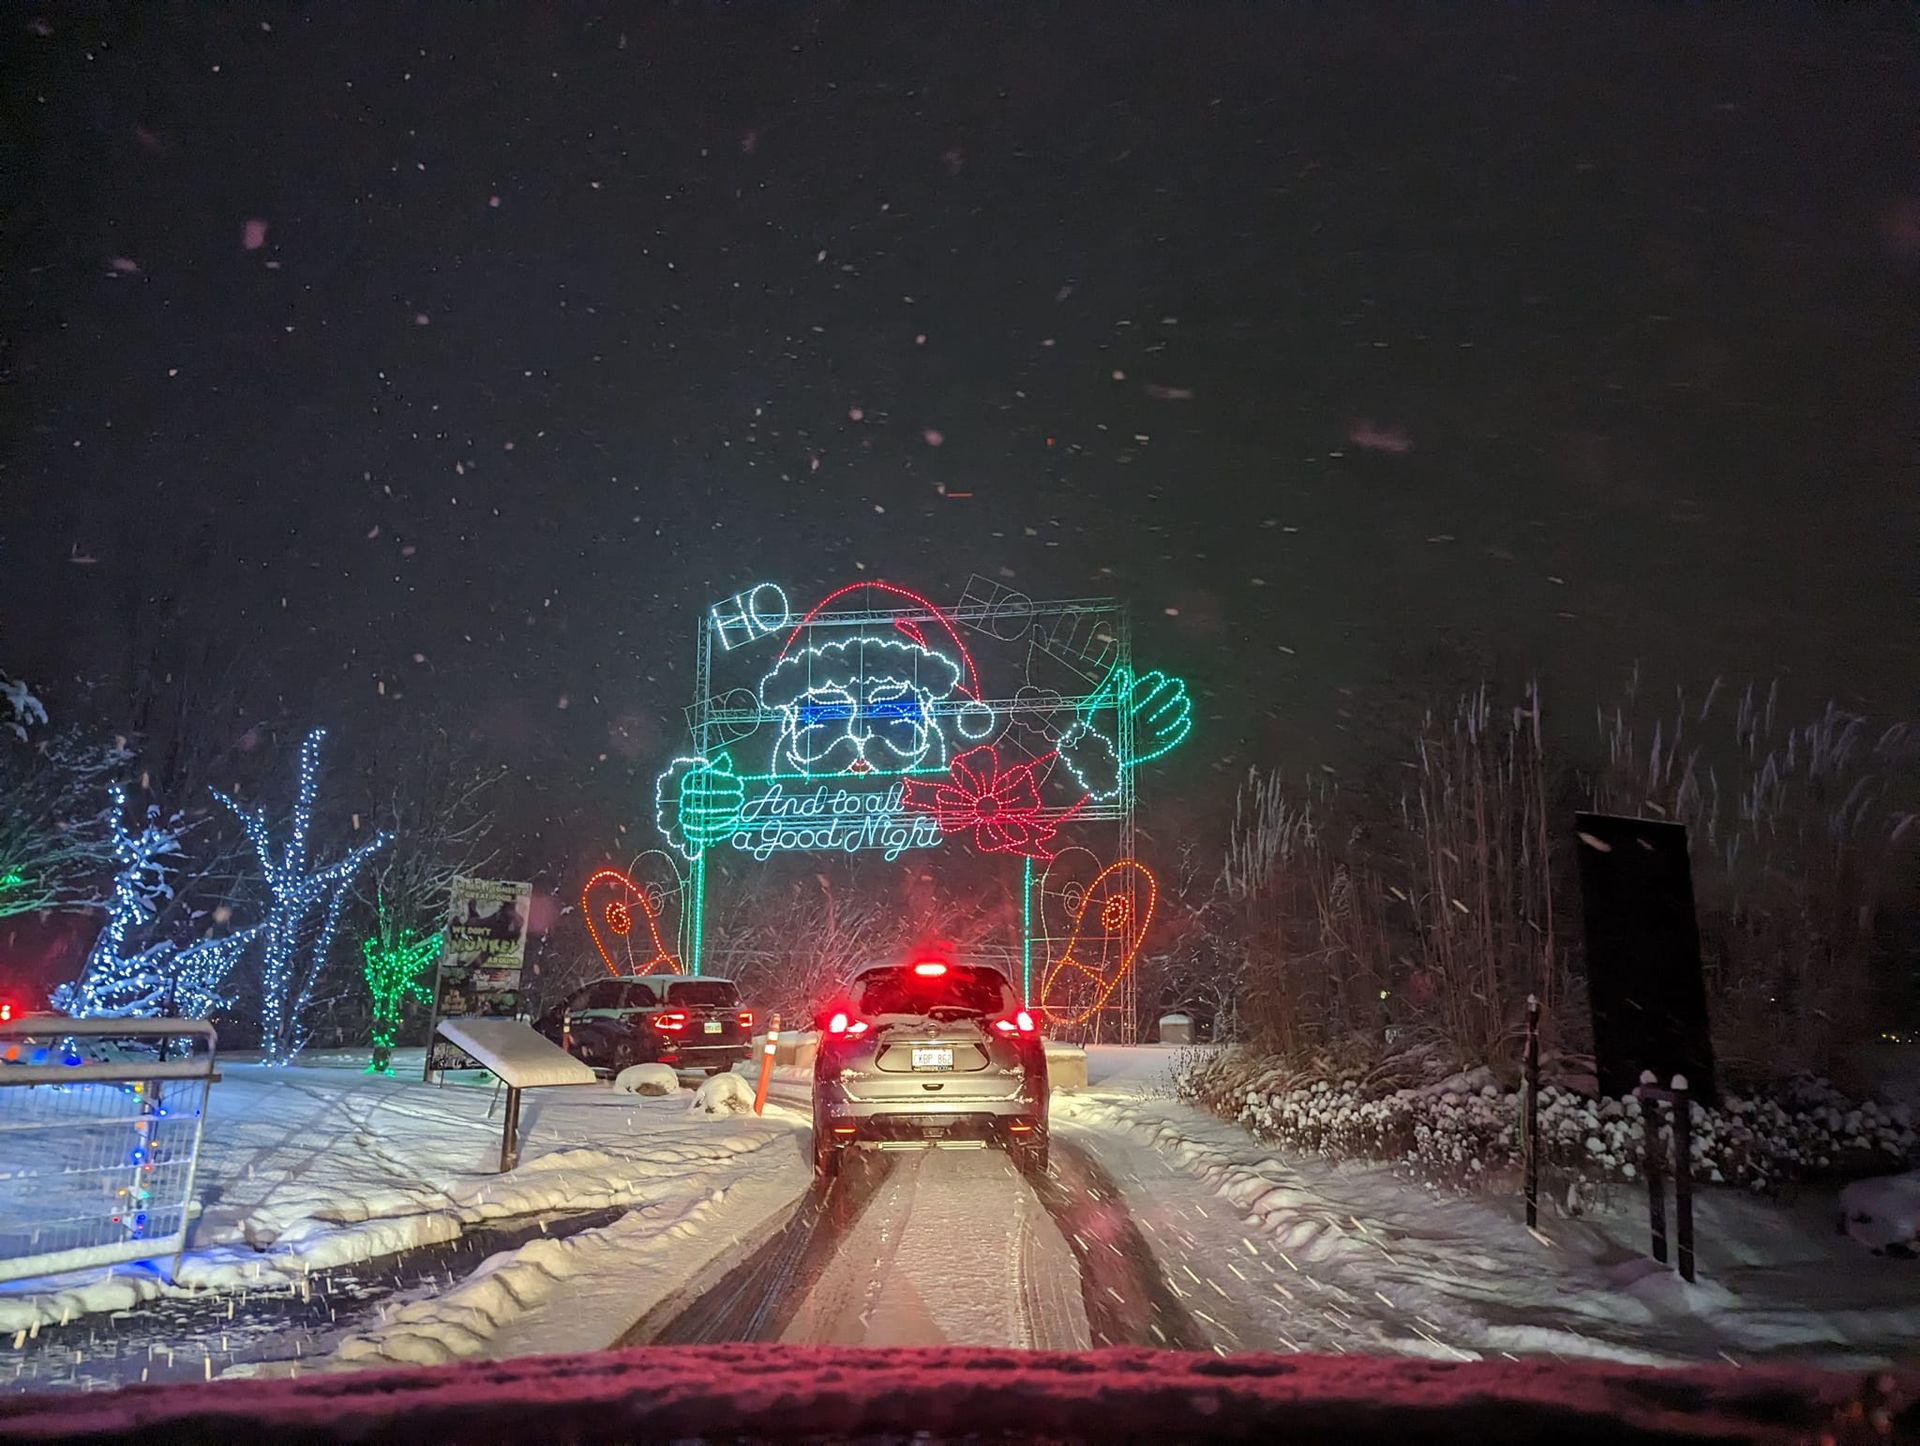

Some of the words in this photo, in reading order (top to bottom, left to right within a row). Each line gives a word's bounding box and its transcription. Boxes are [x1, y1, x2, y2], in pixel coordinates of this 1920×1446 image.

[711, 582, 790, 651] HO
[740, 783, 829, 822] And
[828, 789, 862, 814] to
[865, 781, 905, 812] all
[731, 830, 756, 850] a
[844, 814, 944, 862] Night
[452, 926, 466, 934] WE
[450, 936, 520, 955] MONKEY
[487, 956, 520, 965] AROUND
